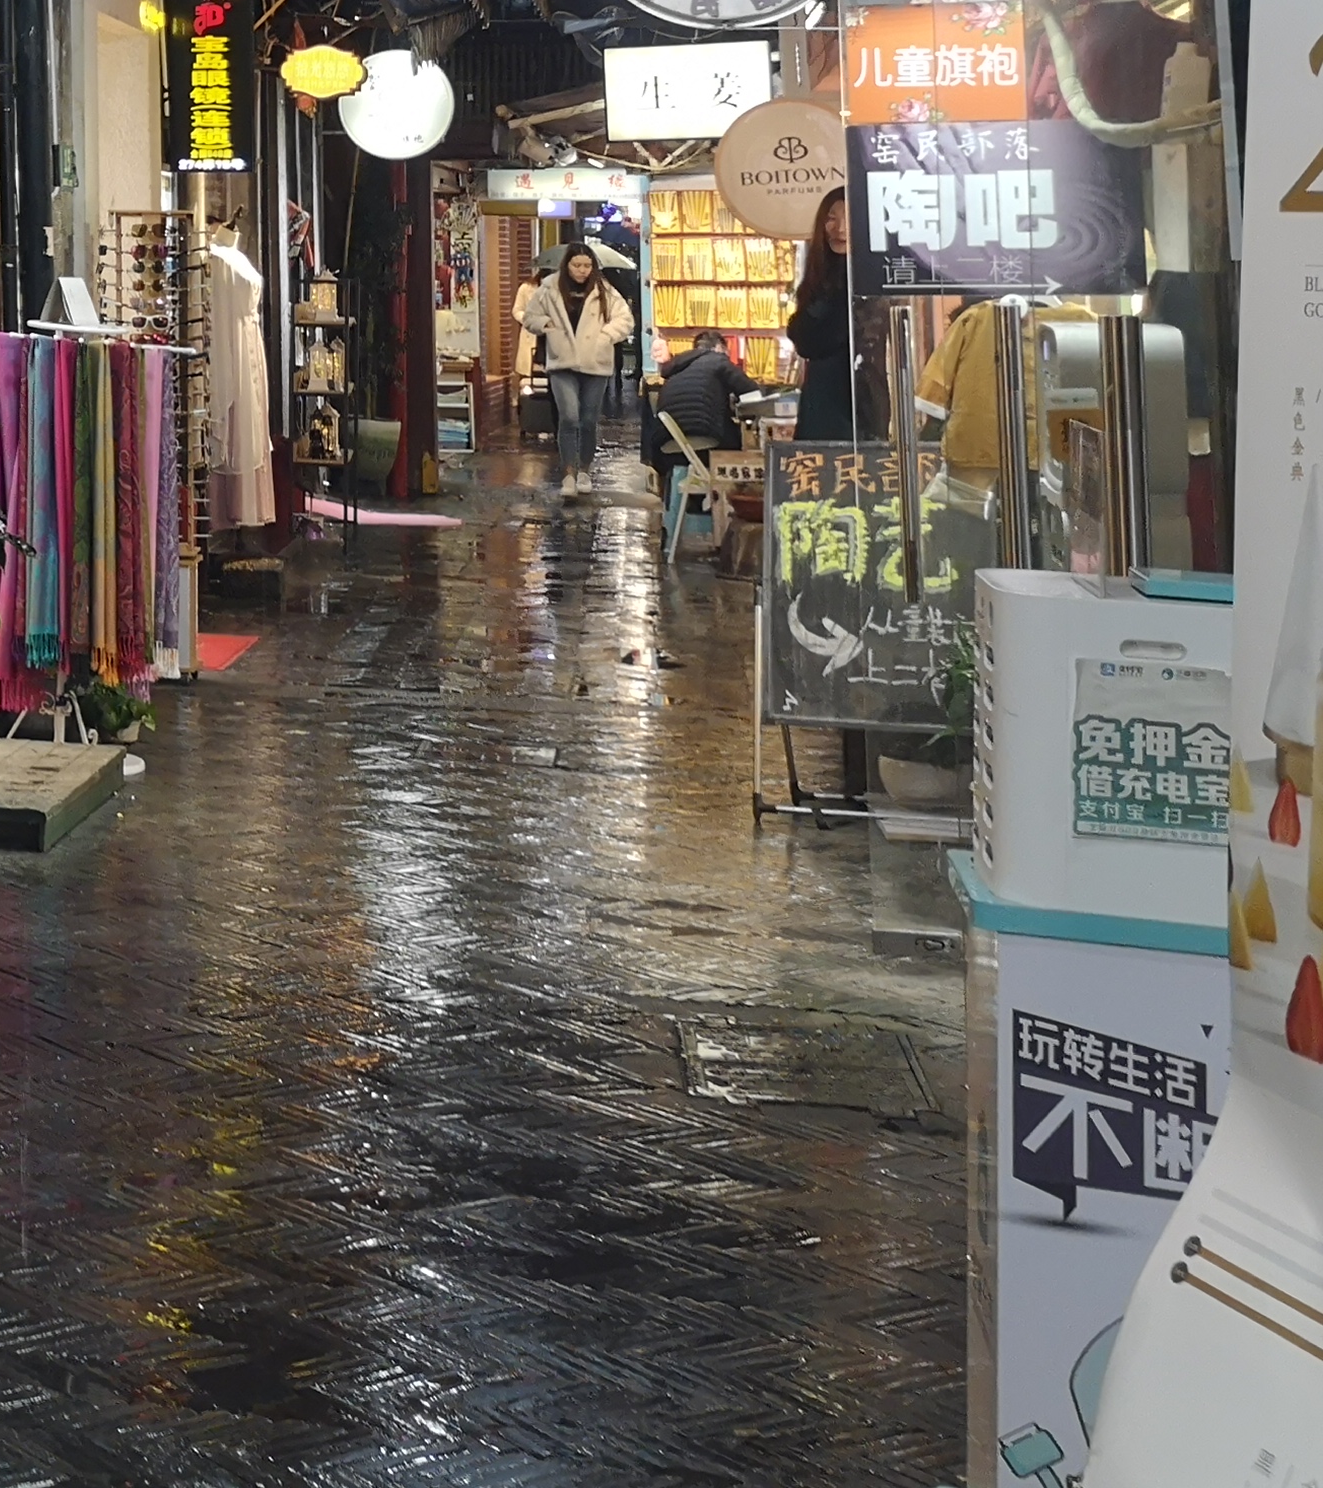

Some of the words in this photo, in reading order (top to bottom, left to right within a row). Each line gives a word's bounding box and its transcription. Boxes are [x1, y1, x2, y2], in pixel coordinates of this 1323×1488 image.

[854, 44, 1019, 89] 儿童旗袍
[870, 127, 1041, 164] 窑民部落
[740, 165, 845, 187] BOITOWN
[766, 186, 823, 196] PARFUMS
[866, 169, 1059, 253] 陶吧
[882, 254, 1024, 286] 请上二楼
[1078, 717, 1231, 772] 免押金
[1077, 765, 1231, 808] 借充电宝
[1078, 799, 1146, 822] 支付宝
[1163, 806, 1230, 830] 扫一扫
[1017, 1016, 1198, 1108] 玩转生活
